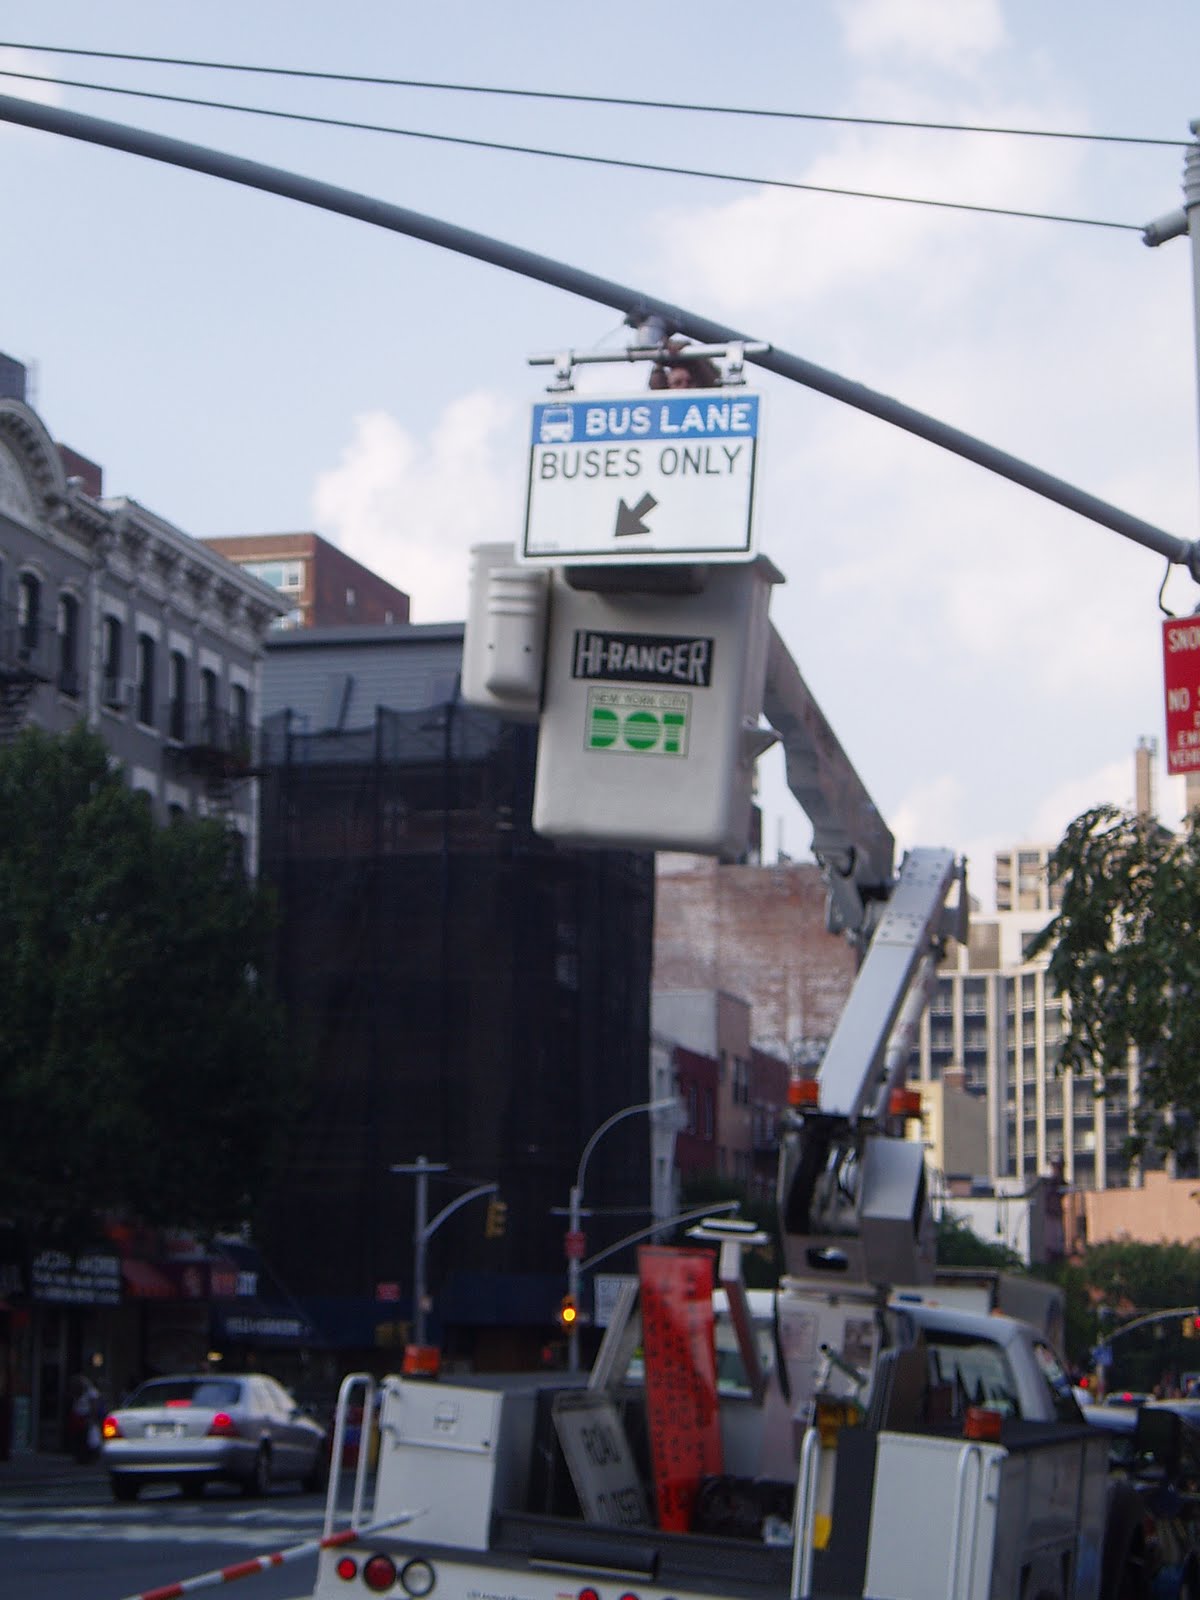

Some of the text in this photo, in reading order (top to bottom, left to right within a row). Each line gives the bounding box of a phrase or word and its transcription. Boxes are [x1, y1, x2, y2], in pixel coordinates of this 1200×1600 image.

[585, 402, 751, 436] BUS LANE
[540, 445, 743, 480] BUSES ONLY
[1168, 687, 1190, 713] NO
